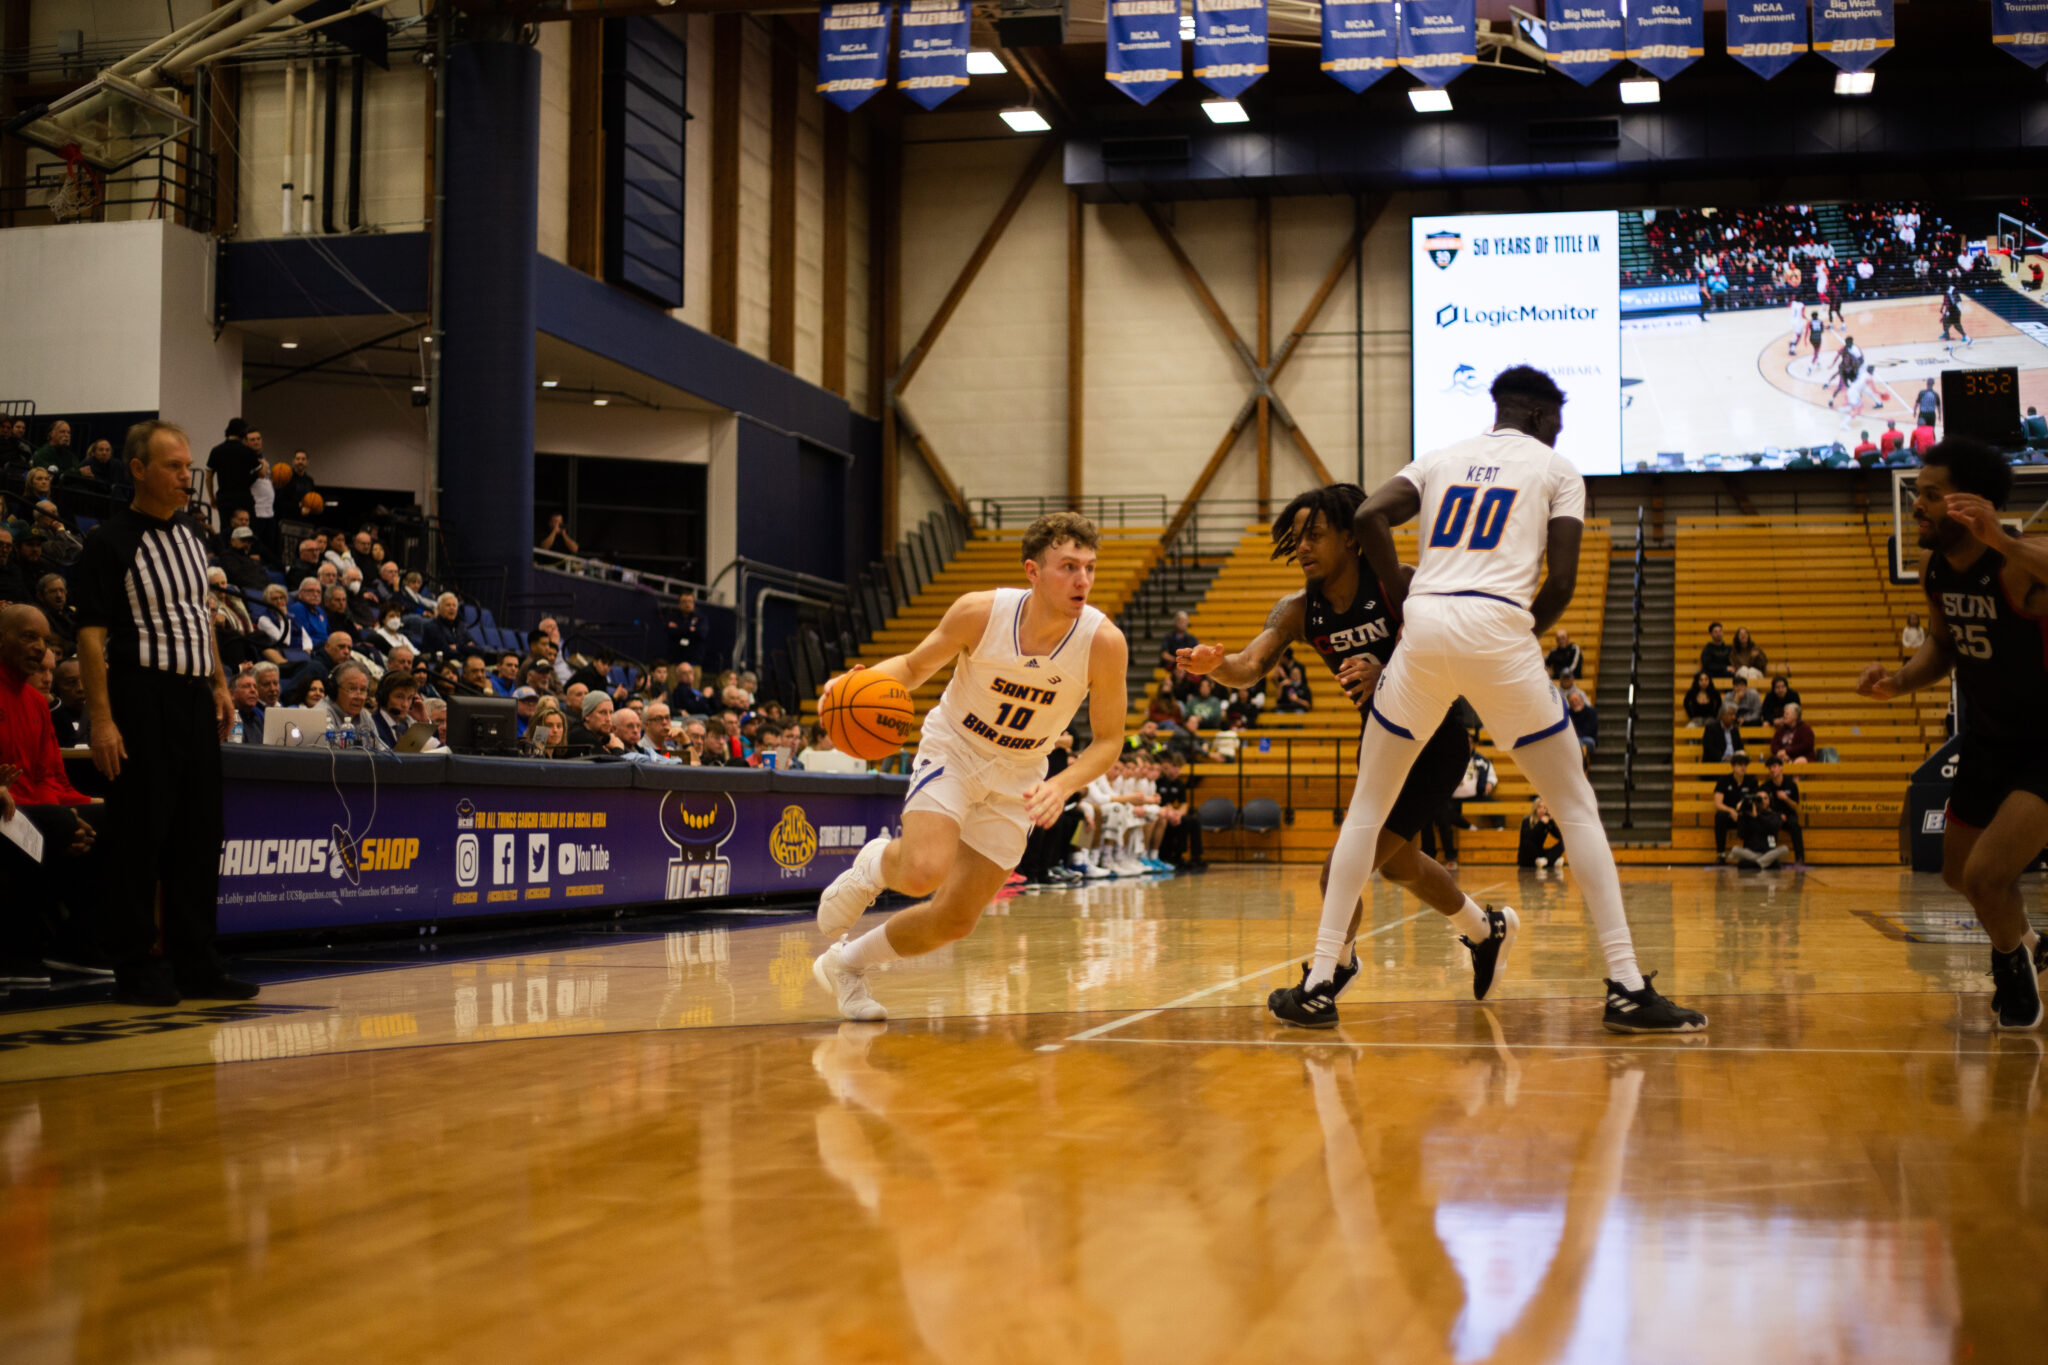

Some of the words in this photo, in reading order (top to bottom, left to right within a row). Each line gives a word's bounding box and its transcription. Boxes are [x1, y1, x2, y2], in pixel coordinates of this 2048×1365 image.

[1651, 5, 1680, 15] NCAA
[1753, 3, 1783, 13] NCAA
[1830, 0, 1848, 10] Big
[1849, 0, 1876, 8] West
[1423, 15, 1454, 25] NCAA
[1563, 9, 1580, 20] Big
[1581, 8, 1606, 18] West
[1738, 13, 1796, 24] Tournament
[1824, 9, 1882, 20] Champions
[1345, 19, 1375, 29] NCAA
[1549, 19, 1621, 31] Championships
[1637, 17, 1692, 26] Tournament
[1130, 31, 1160, 40] NCAA
[1209, 25, 1226, 37] Big
[1226, 24, 1250, 34] West
[1330, 29, 1387, 39] Tournament
[1410, 25, 1466, 36] Tournament
[913, 39, 929, 49] Big
[930, 38, 952, 47] West
[1195, 34, 1265, 46] Championships
[2013, 32, 2048, 45] 196
[840, 43, 868, 52] NCAA
[1118, 41, 1171, 51] Tournament
[1640, 44, 1690, 59] 2006
[1741, 42, 1793, 57] 2009
[1830, 38, 1877, 53] 2013
[826, 53, 879, 62] Tournament
[899, 47, 966, 59] Championships
[1560, 48, 1611, 64] 2005
[1333, 56, 1384, 72] 2004
[1413, 52, 1464, 68] 2005
[1120, 68, 1169, 84] 2003
[1205, 63, 1255, 78] 2004
[827, 78, 875, 92] 2002
[908, 75, 955, 89] 2003
[1473, 238, 1489, 256] 50
[1494, 236, 1531, 255] YEARS
[1536, 235, 1549, 254] OF
[1554, 235, 1583, 254] TITLE
[1588, 234, 1600, 253] IX
[1464, 303, 1599, 327] LogicMonitor
[1551, 365, 1601, 376] ARBARA
[1965, 373, 2012, 396] 3:52
[1465, 465, 1501, 482] KEAT
[1428, 483, 1520, 552] 00
[1941, 592, 1998, 620] SUN
[990, 676, 1058, 705] SANTA
[994, 701, 1036, 731] 10
[1801, 802, 1821, 812] Help
[1824, 802, 1848, 812] Keep
[1851, 802, 1872, 811] Area
[1875, 802, 1899, 811] Clear
[218, 839, 328, 876] AUCHOS
[360, 838, 420, 871] SHOP
[576, 844, 610, 871] YouTube
[667, 863, 729, 900] UCSB
[225, 893, 244, 905] Lobby
[245, 892, 257, 903] and
[257, 891, 278, 902] Online
[279, 891, 286, 901] at
[339, 887, 357, 898] Where
[357, 886, 380, 897] Gauchos
[380, 886, 390, 896] Get
[390, 885, 404, 895] Their
[404, 884, 419, 894] Gear!
